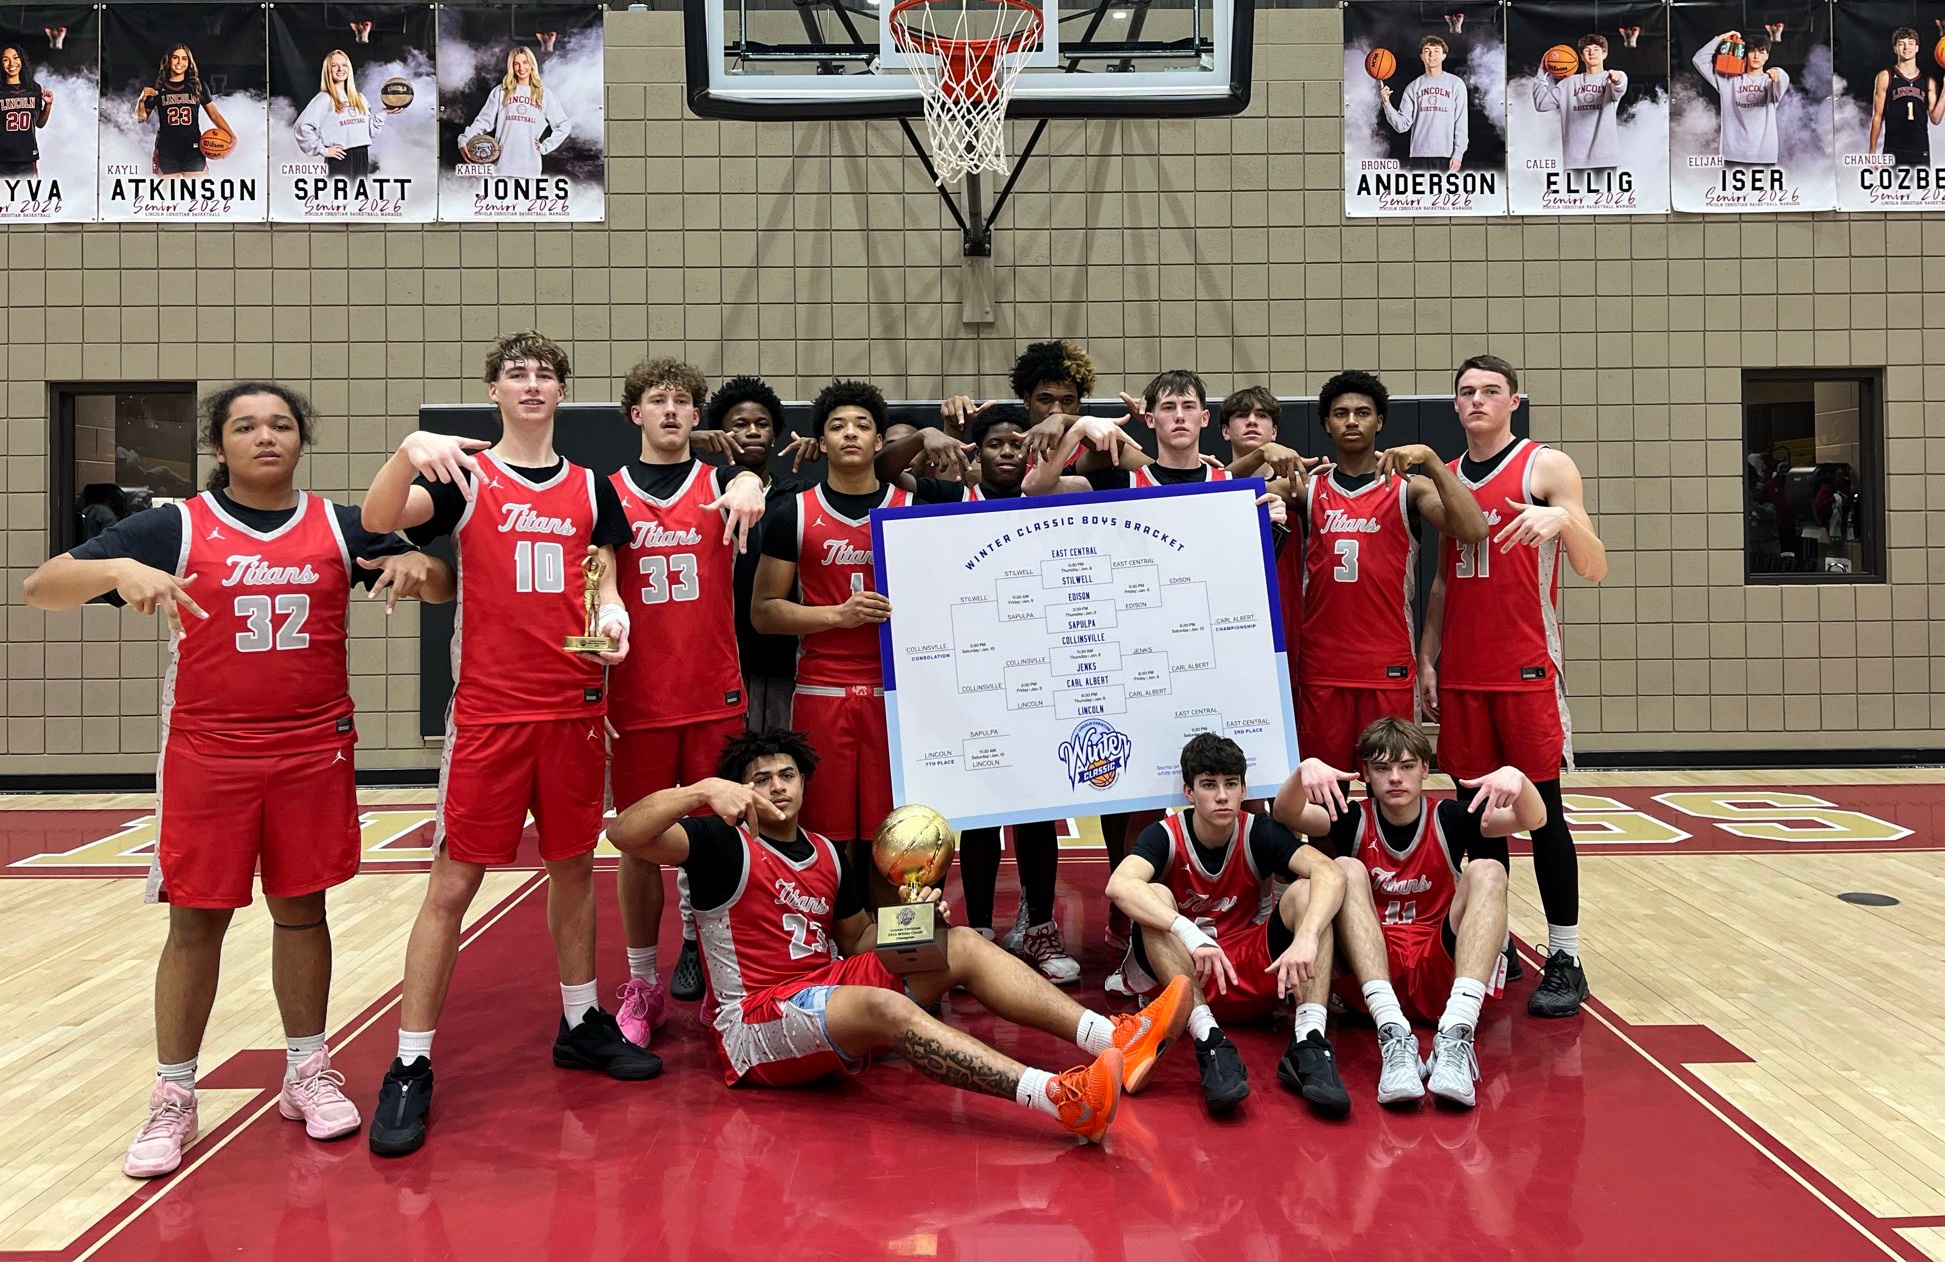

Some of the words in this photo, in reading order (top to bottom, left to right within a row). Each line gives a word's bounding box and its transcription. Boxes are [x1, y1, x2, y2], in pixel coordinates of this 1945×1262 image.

[1417, 87, 1451, 98] LINCOLN
[0, 97, 36, 111] LINCOLN
[167, 106, 192, 126] 23
[1907, 101, 1914, 120] 1
[6, 111, 31, 131] 20
[1361, 160, 1398, 170] BRONCO
[1526, 159, 1557, 169] CALEB
[1688, 157, 1724, 167] ELIJAH
[1844, 155, 1895, 165] CHANDLER
[107, 165, 138, 175] KAYLI
[281, 165, 328, 175] CAROLYN
[457, 165, 492, 175] KARLIE
[1356, 173, 1495, 195] ANDERSON
[1546, 171, 1632, 194] ELLIG
[1721, 169, 1783, 191] ISER
[111, 178, 256, 200] ATKINSON
[294, 178, 412, 200] SPRATT
[475, 178, 569, 200] JONES
[1870, 185, 1912, 203] Senior
[1379, 190, 1423, 209] Senior
[1431, 191, 1472, 206] 2026
[1542, 189, 1586, 207] Senior
[1594, 190, 1636, 205] 2026
[1705, 186, 1748, 205] Senior
[1757, 187, 1799, 202] 2026
[20, 199, 62, 213] 2026
[133, 195, 180, 214] Senior
[188, 197, 232, 213] 2026
[304, 195, 350, 213] Senior
[358, 197, 402, 212] 2026
[474, 195, 519, 213] Senior
[527, 198, 569, 212] 2026
[497, 502, 576, 537] Titans
[1320, 508, 1381, 535] Titans
[630, 520, 702, 550] Titans
[965, 534, 1011, 571] WINTER
[1017, 517, 1074, 537] CLASSIC
[1082, 516, 1117, 526] BOYS
[1124, 520, 1185, 552] BRACKET
[821, 539, 874, 566] Titan
[1052, 548, 1068, 558] EAST
[1070, 546, 1098, 557] CENTRAL
[513, 540, 566, 594] 10
[1128, 558, 1155, 566] CENTRAL
[1333, 539, 1359, 583] 3
[221, 554, 319, 588] Titans
[1004, 569, 1034, 577] STILWELL
[639, 552, 700, 605] 33
[1062, 575, 1093, 585] STILWELL
[1169, 576, 1191, 584] EDISON
[1068, 592, 1090, 602] EDISON
[1007, 612, 1034, 620] SAPULPA
[1216, 617, 1231, 625] CARL
[1232, 614, 1254, 623] ALBERT
[233, 593, 310, 653] 32
[1068, 619, 1096, 630] SAPULPA
[1215, 624, 1257, 632] CHAMPIONSHIP
[1062, 633, 1105, 645] COLLINSVILLE
[906, 643, 947, 653] COLLINSVILLE
[1132, 647, 1153, 655] JENKS
[911, 653, 950, 661] CONSOLATION
[1005, 656, 1046, 666] COLLINSVILLE
[1076, 662, 1097, 672] JENKS
[1188, 661, 1209, 670] ALBERT
[961, 682, 1002, 692] COLLINSVILLE
[1066, 679, 1082, 688] CARL
[1085, 676, 1109, 686] ALBERT
[1144, 688, 1167, 697] ALBERT
[1017, 700, 1043, 709] LINCOLN
[1078, 705, 1104, 716] LINCOLN
[1175, 710, 1190, 718] EAST
[1191, 707, 1218, 716] CENTRAL
[1242, 718, 1270, 726] CENTRAL
[970, 729, 999, 738] SAPULPA
[924, 750, 952, 759] LINCOLN
[1058, 726, 1132, 794] Winter
[972, 760, 1000, 768] LINCOLN
[1083, 762, 1116, 781] CLASSIC
[1382, 900, 1416, 925] 11
